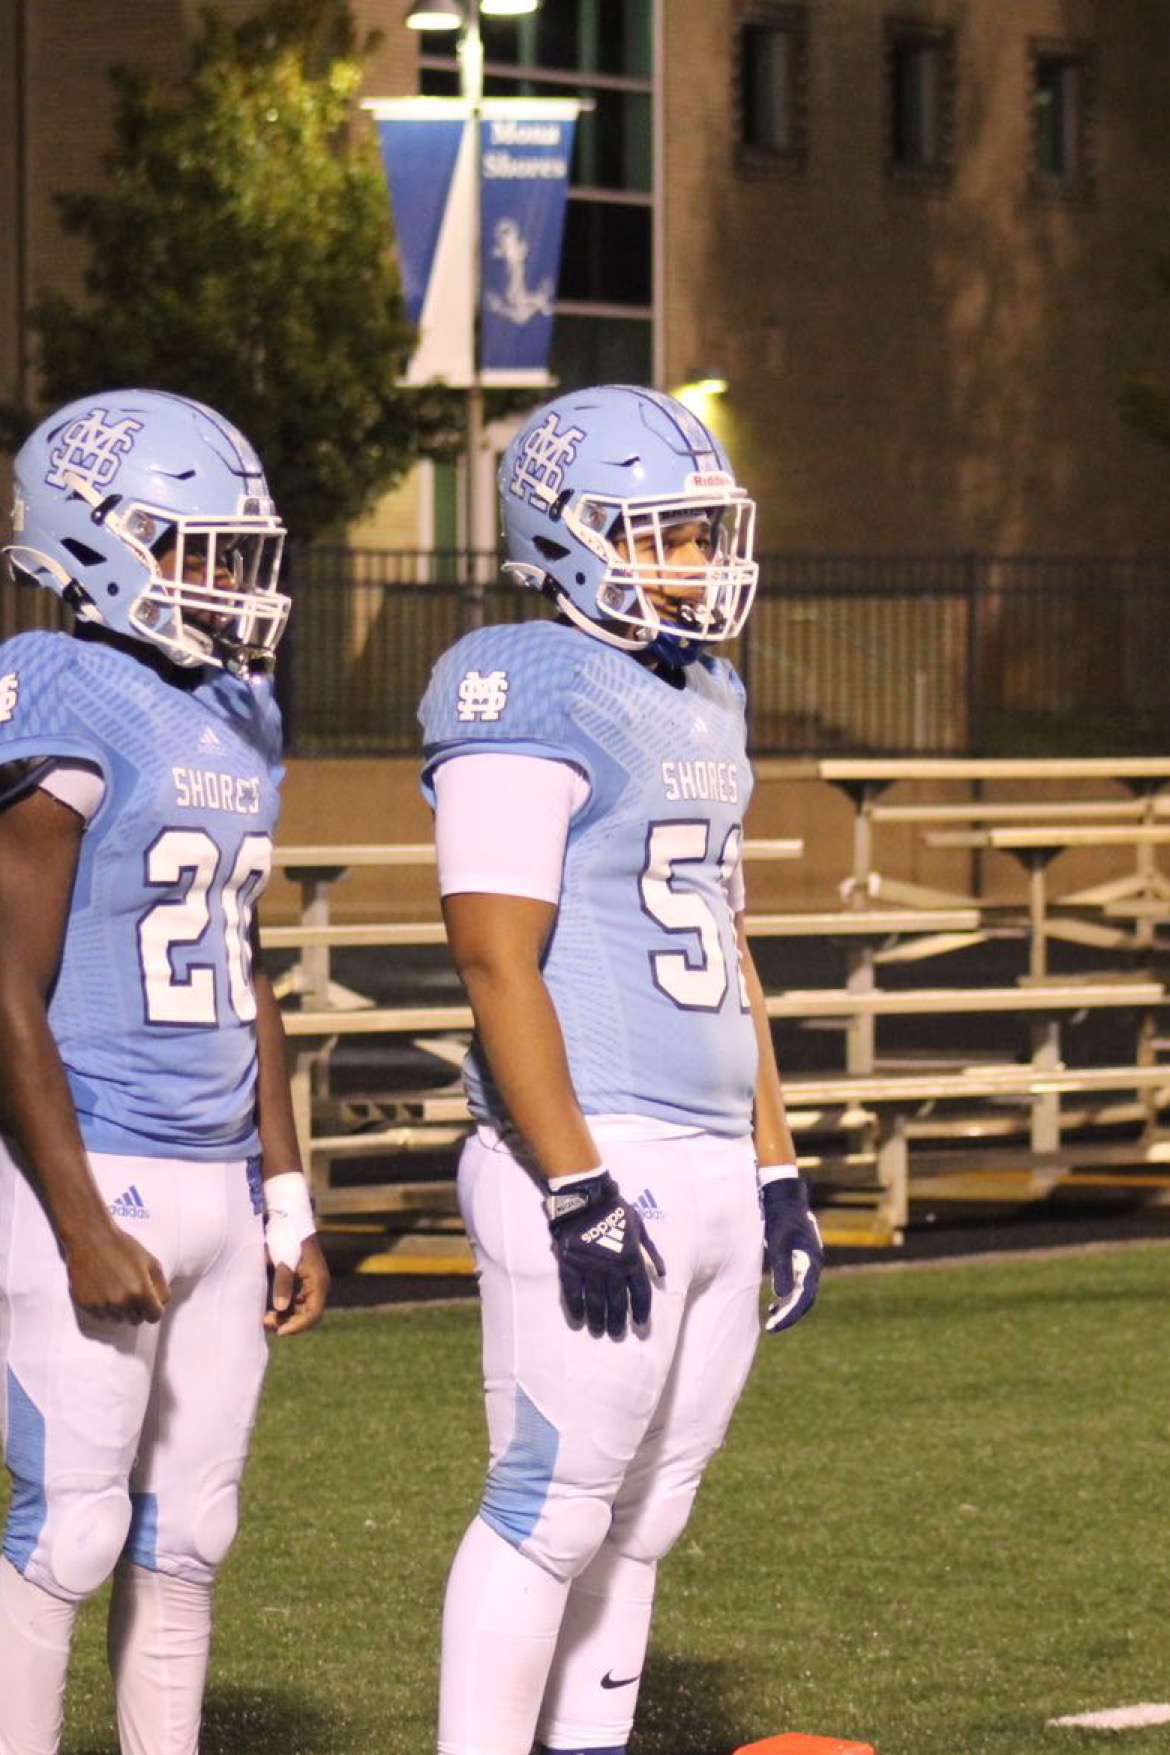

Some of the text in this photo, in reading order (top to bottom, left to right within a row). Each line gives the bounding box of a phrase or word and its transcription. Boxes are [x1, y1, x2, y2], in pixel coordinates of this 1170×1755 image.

[171, 766, 260, 814] SHORES
[661, 761, 738, 804] SHORES
[136, 826, 273, 1029] 20
[581, 1206, 625, 1244] adidas
